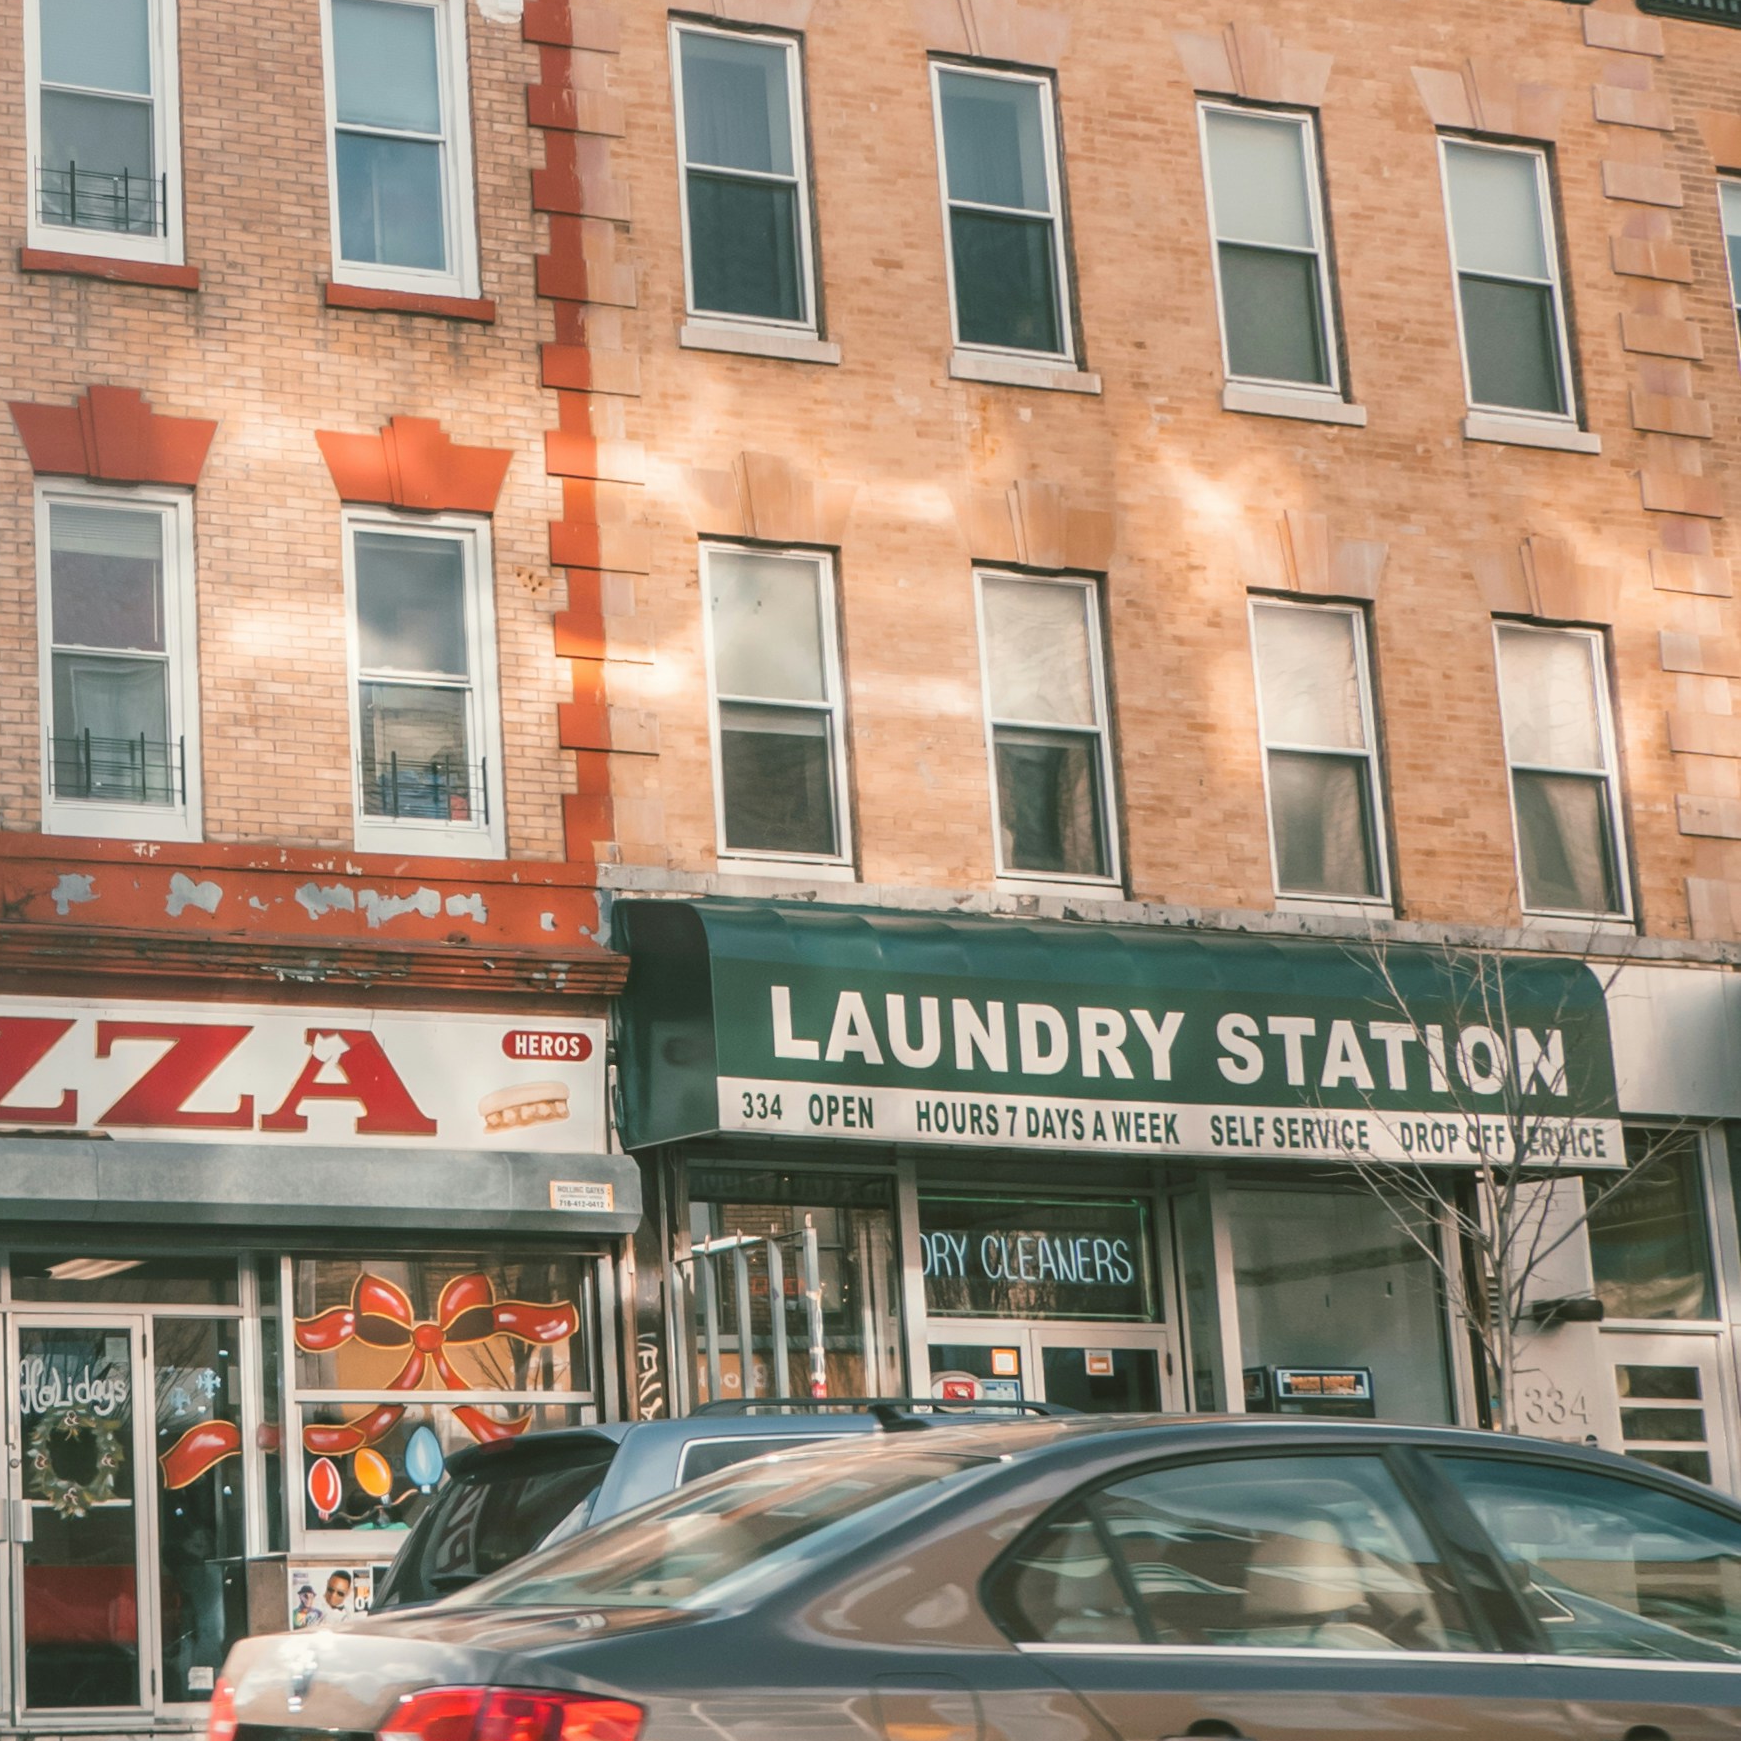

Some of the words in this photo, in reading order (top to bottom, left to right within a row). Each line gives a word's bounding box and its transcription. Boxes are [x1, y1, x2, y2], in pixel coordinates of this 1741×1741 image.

[515, 1034, 580, 1057] HEROS
[771, 985, 1185, 1081] LAUNDRY
[1216, 1012, 1568, 1097] STATION
[741, 1092, 782, 1120] 334
[808, 1093, 874, 1129] OPEN
[916, 1100, 999, 1137] HOURS
[1006, 1105, 1018, 1137] 7
[1026, 1107, 1085, 1141] DAYS
[1093, 1109, 1107, 1141] A
[1112, 1111, 1180, 1144] WEEK
[1211, 1114, 1264, 1147] SELF
[1273, 1116, 1370, 1150] SERVICE
[1400, 1122, 1457, 1154] DROP
[1466, 1124, 1505, 1154] OFF
[1512, 1125, 1606, 1158] ERVICE
[980, 1235, 1134, 1284] CLEANERS
[1524, 1388, 1590, 1425] 334
